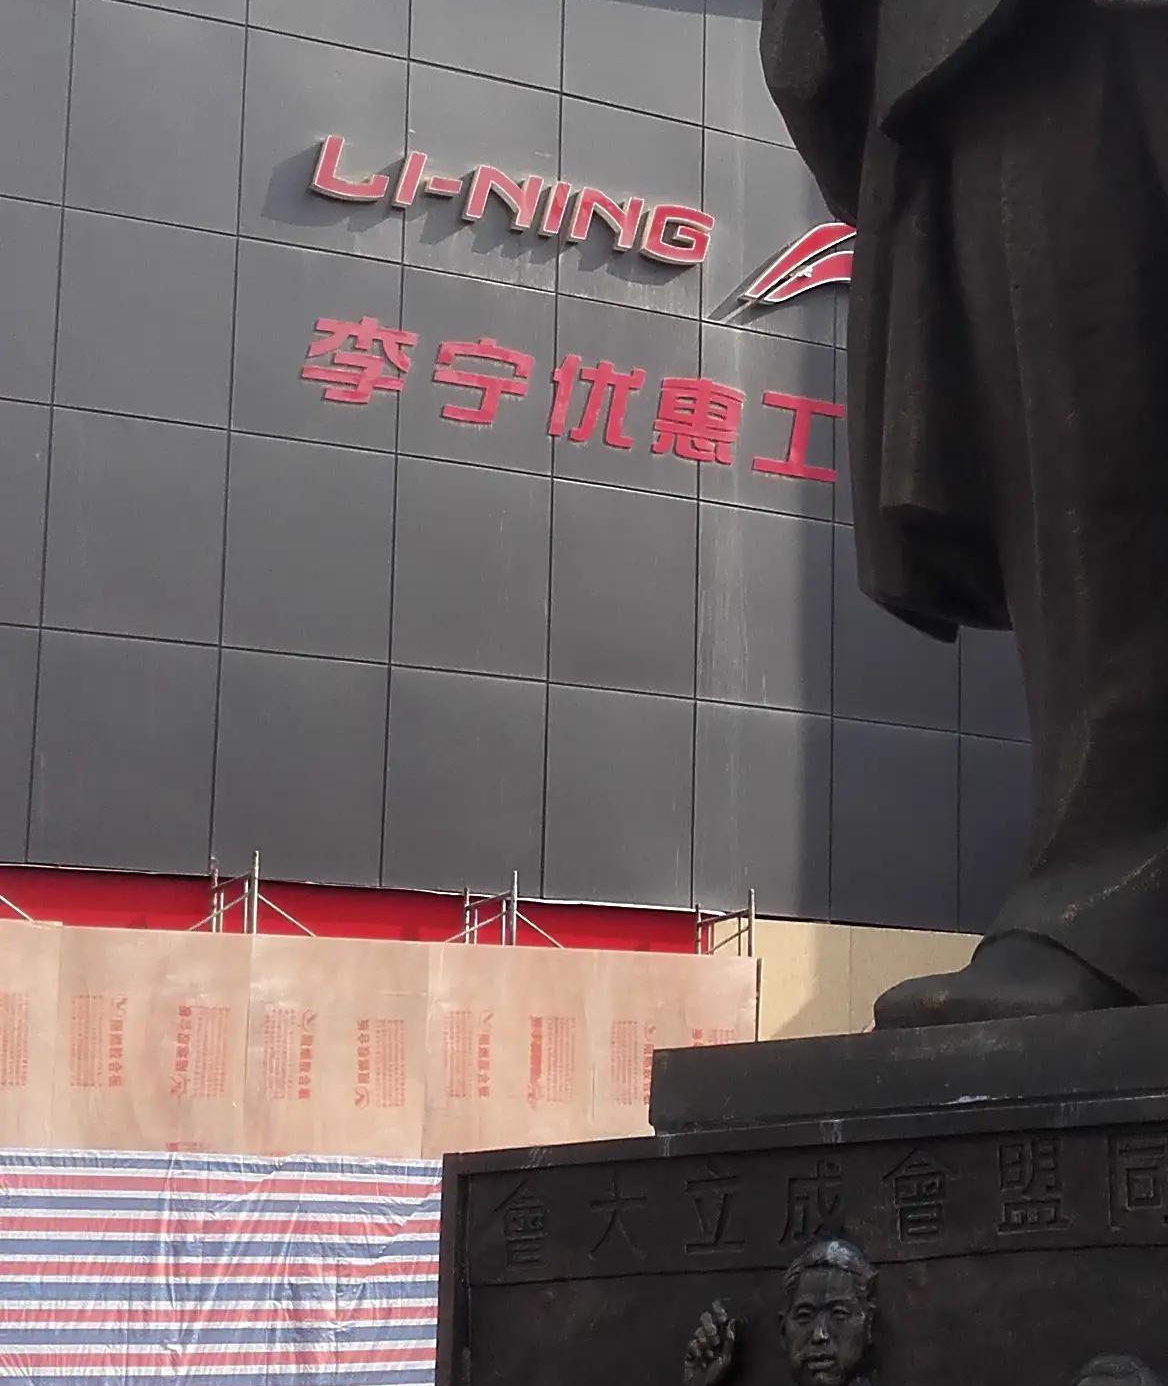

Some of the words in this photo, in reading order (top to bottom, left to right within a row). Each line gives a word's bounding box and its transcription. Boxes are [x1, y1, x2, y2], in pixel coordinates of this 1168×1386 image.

[312, 134, 716, 265] LI-NING
[302, 316, 846, 483] 李宁优惠工
